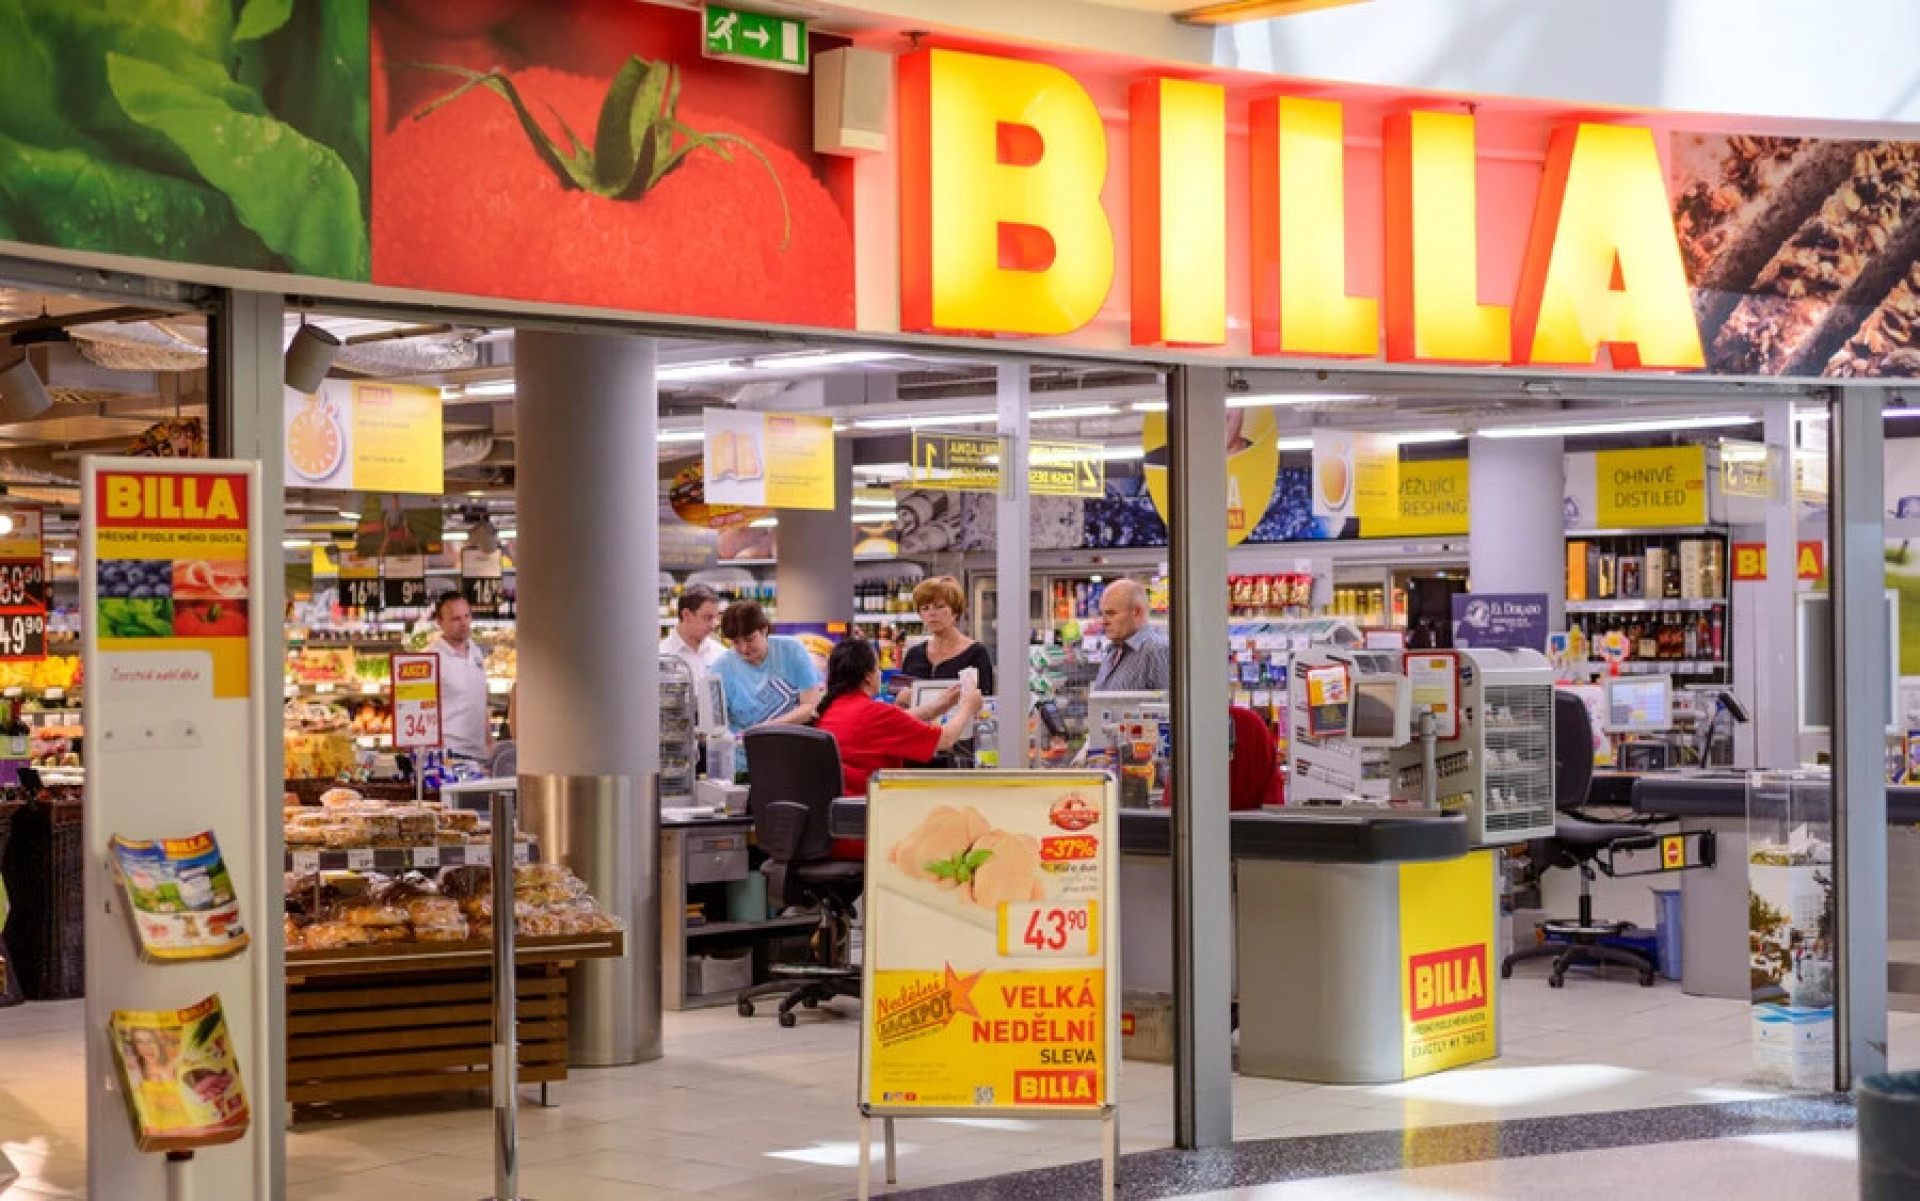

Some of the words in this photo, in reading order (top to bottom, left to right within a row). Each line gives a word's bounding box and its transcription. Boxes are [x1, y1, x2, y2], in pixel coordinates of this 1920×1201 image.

[900, 48, 1706, 371] BILLA
[1614, 465, 1673, 485] OHNIVÉ
[106, 475, 239, 520] BILLA
[1737, 547, 1818, 575] BIA
[405, 714, 427, 738] 34
[1047, 839, 1094, 858] -37%
[1024, 909, 1067, 950] 43
[1068, 910, 1087, 930] 90
[1001, 978, 1096, 1008] VELKÁ
[1416, 956, 1484, 1011] BILLA
[972, 1012, 1096, 1042] NEDĚLNÍ
[1040, 1049, 1096, 1064] SLEVA
[1020, 1076, 1091, 1099] BILLA
